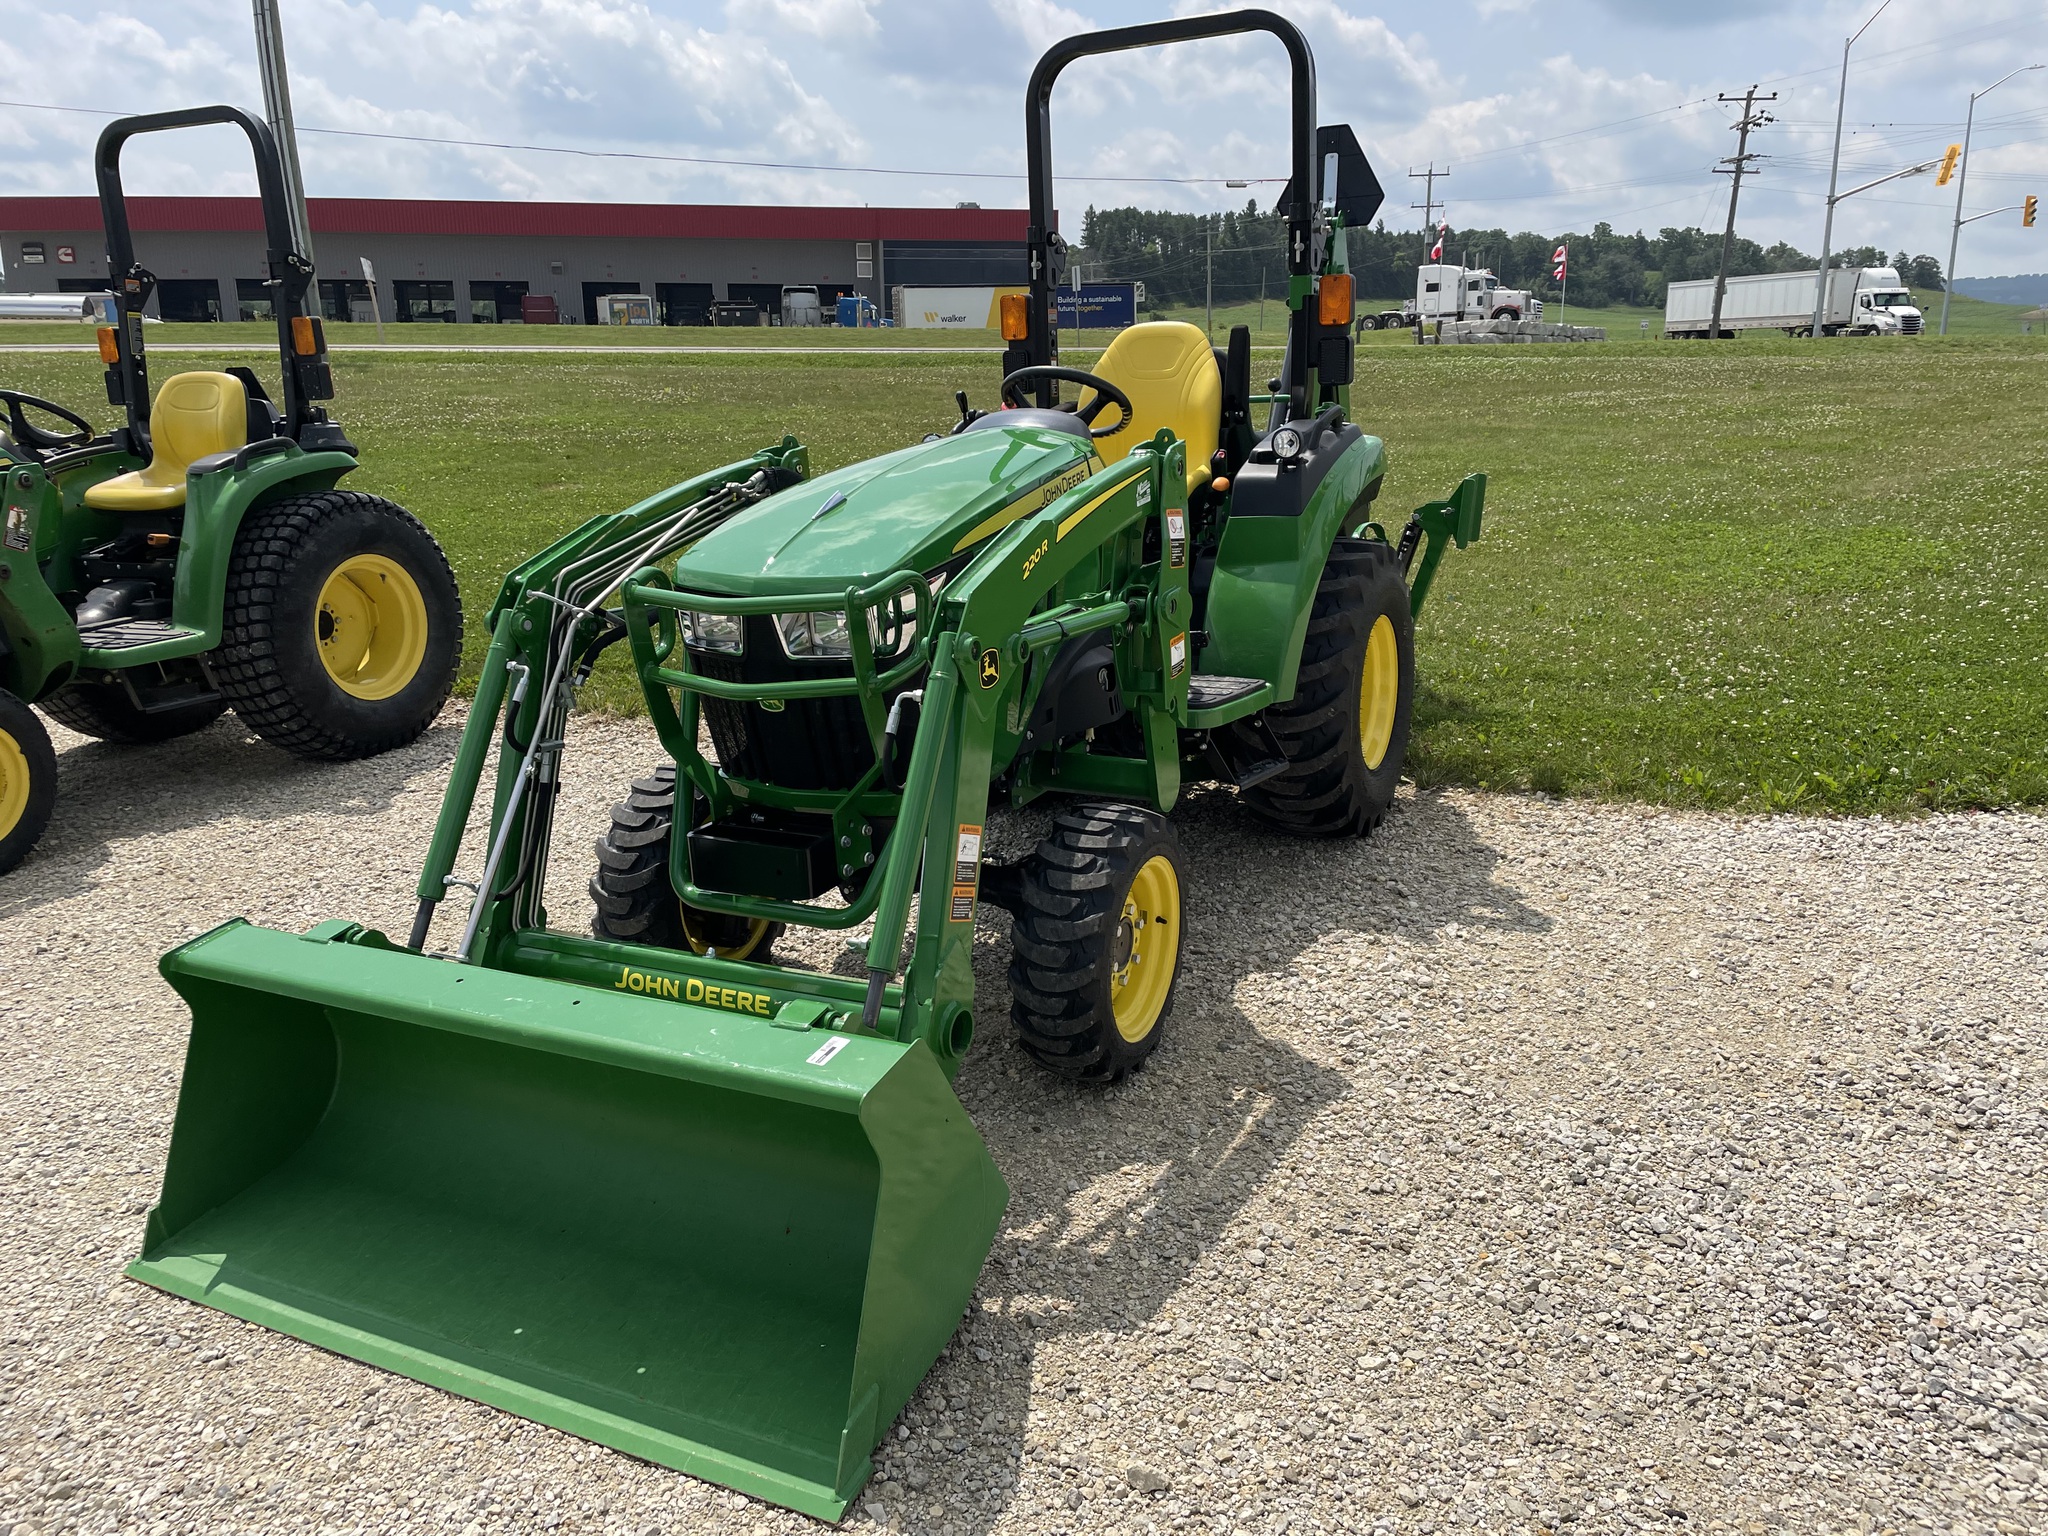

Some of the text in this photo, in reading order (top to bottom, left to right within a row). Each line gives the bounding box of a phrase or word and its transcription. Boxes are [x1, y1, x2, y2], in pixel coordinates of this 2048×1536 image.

[1057, 296, 1082, 304] Building
[1088, 295, 1122, 303] sustainable
[940, 314, 967, 323] walker
[1041, 469, 1086, 507] JOHN DEERE
[615, 967, 771, 1015] JOHN DEERE
